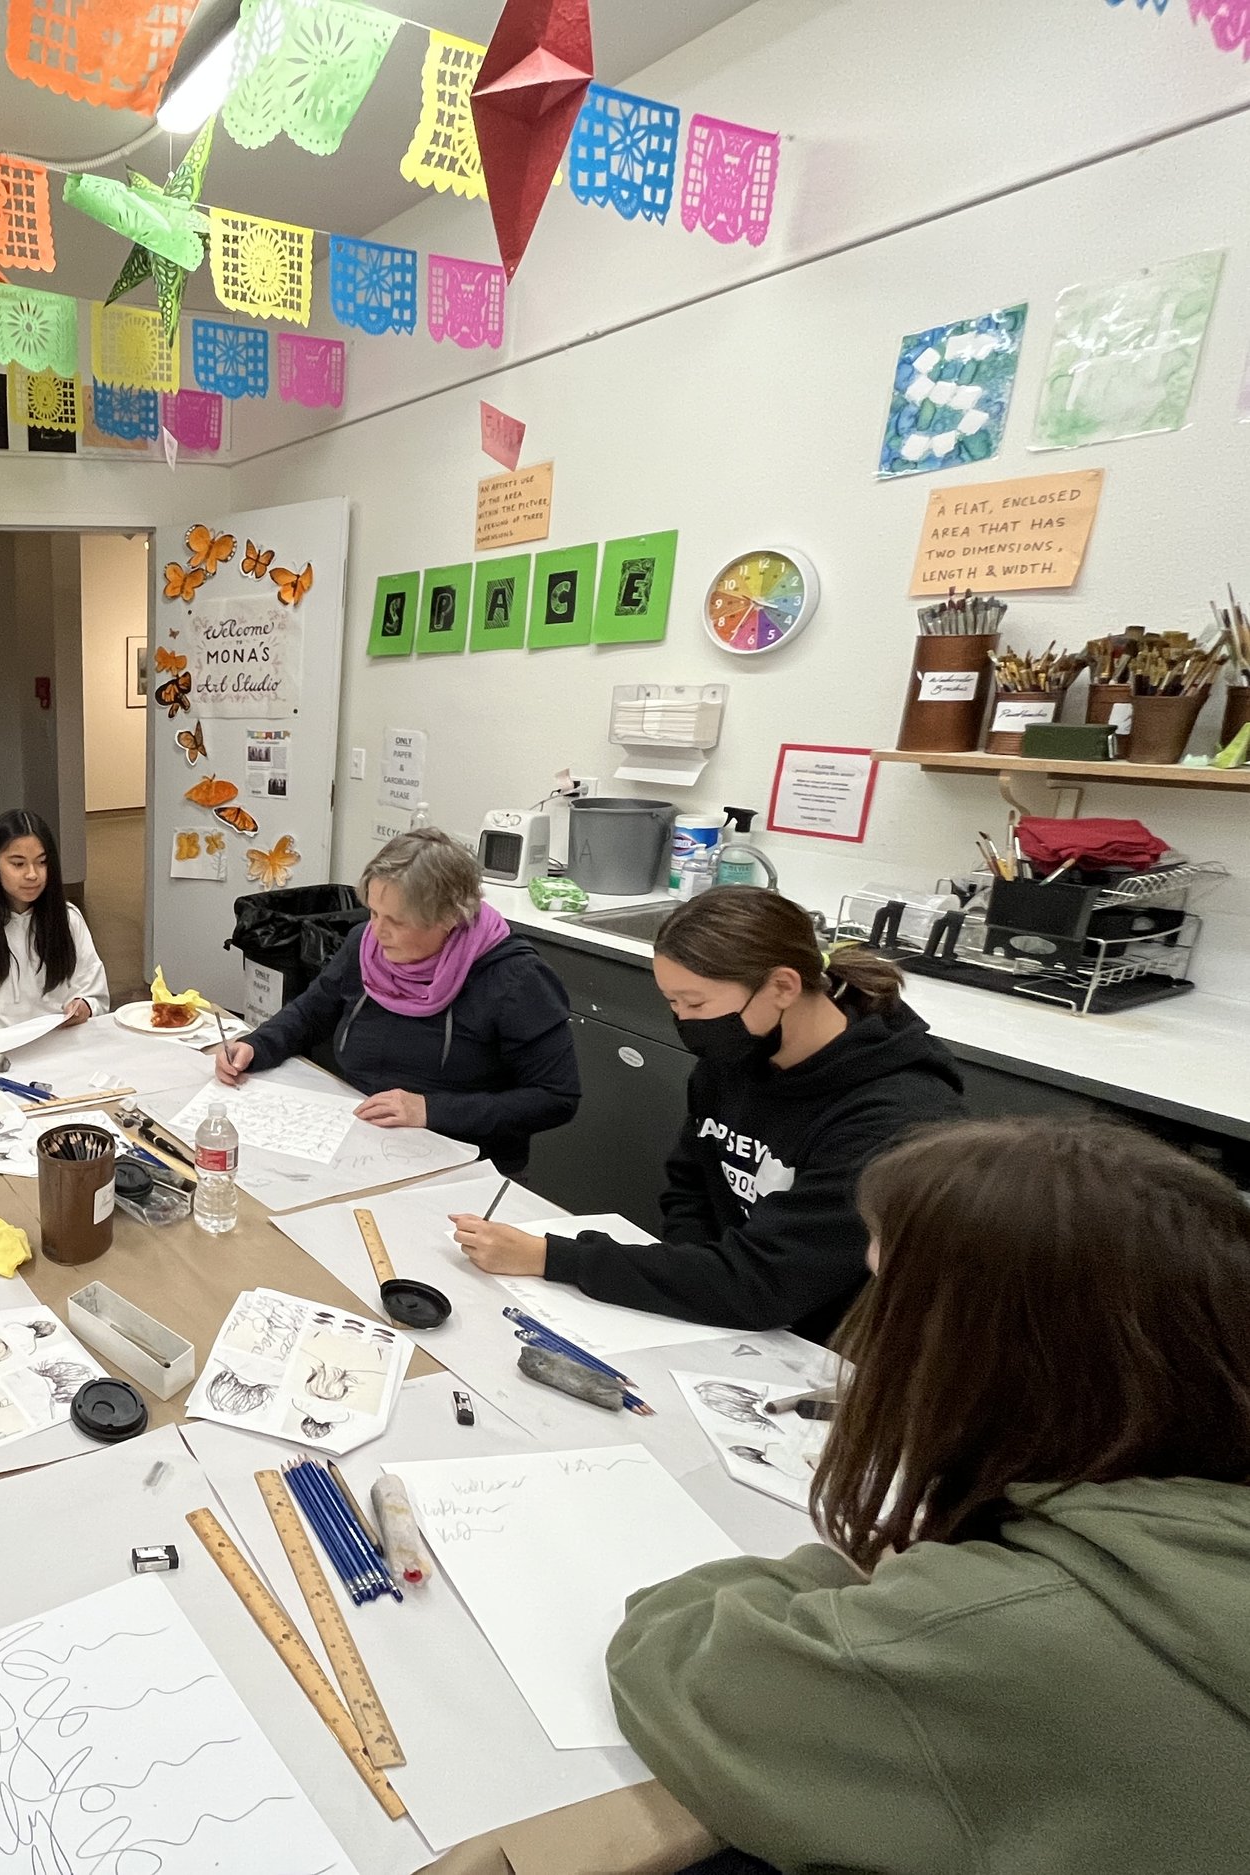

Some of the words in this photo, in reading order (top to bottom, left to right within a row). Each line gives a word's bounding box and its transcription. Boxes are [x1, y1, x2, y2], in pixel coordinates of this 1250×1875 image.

[504, 491, 522, 501] AREA
[502, 504, 515, 513] THE
[937, 506, 946, 518] A
[1002, 488, 1081, 509] ENCLOSED
[931, 526, 970, 540] AREA
[979, 520, 1021, 535] THAT
[1030, 517, 1066, 530] HAS
[925, 549, 956, 561] TWO
[758, 558, 770, 569] 12
[780, 562, 786, 573] 1
[739, 565, 748, 576] 11
[922, 566, 978, 583] LENGTH
[985, 565, 997, 577] &
[724, 579, 736, 591] 10
[791, 576, 799, 587] 2
[383, 571, 648, 636] SPACE
[715, 599, 723, 609] 9
[793, 595, 801, 607] 3
[717, 617, 726, 627] 8
[784, 615, 792, 626] 4
[204, 619, 275, 640] Welcome
[767, 629, 776, 640] 5
[747, 635, 755, 645] 6
[207, 641, 269, 664] MONA'S
[197, 674, 228, 693] Art
[232, 673, 282, 693] Studio
[395, 737, 412, 746] ONLY
[393, 750, 412, 759] PAPER
[383, 775, 419, 787] CARDBOARD
[390, 790, 410, 800] PLEASE
